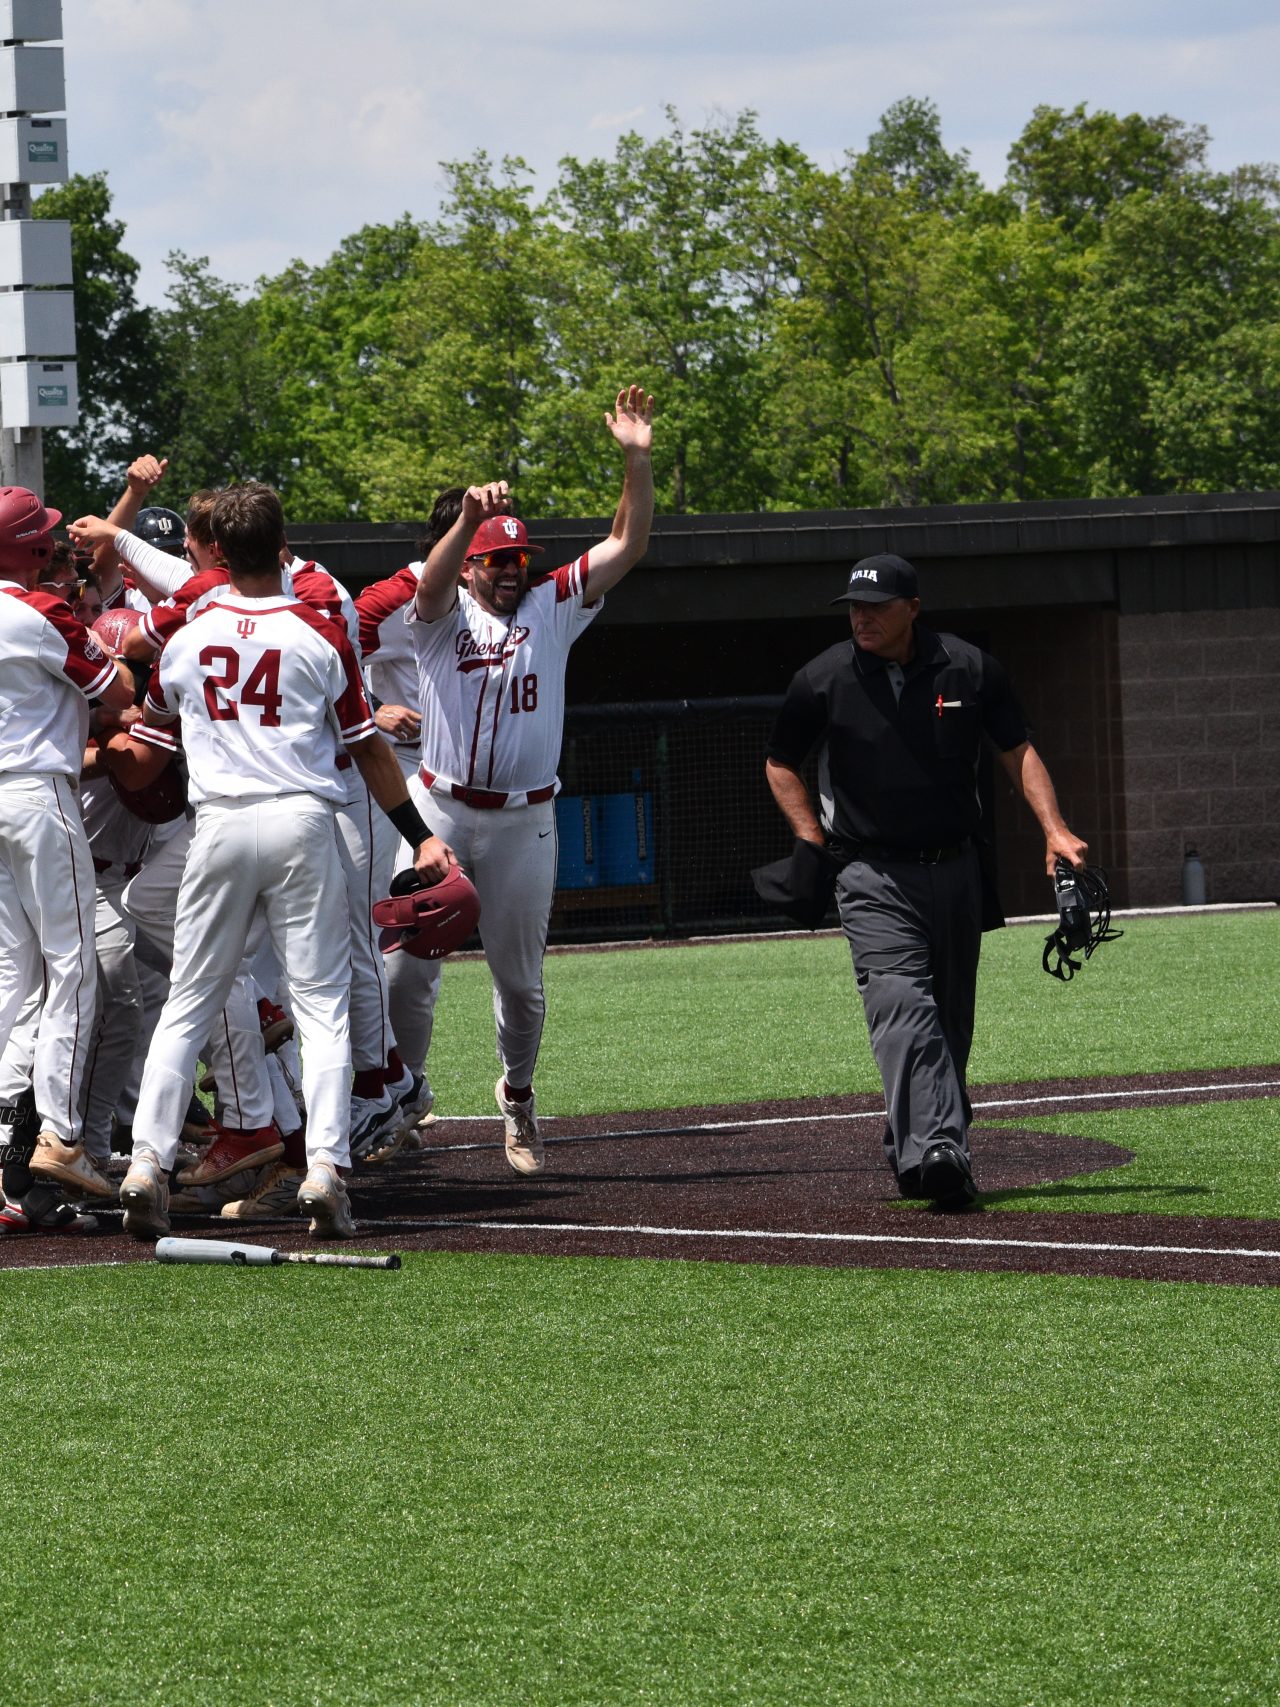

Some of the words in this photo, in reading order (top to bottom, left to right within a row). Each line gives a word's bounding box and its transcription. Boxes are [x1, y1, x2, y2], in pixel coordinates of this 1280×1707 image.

[849, 569, 878, 584] NAIA
[198, 645, 283, 727] 24
[509, 673, 538, 715] 18
